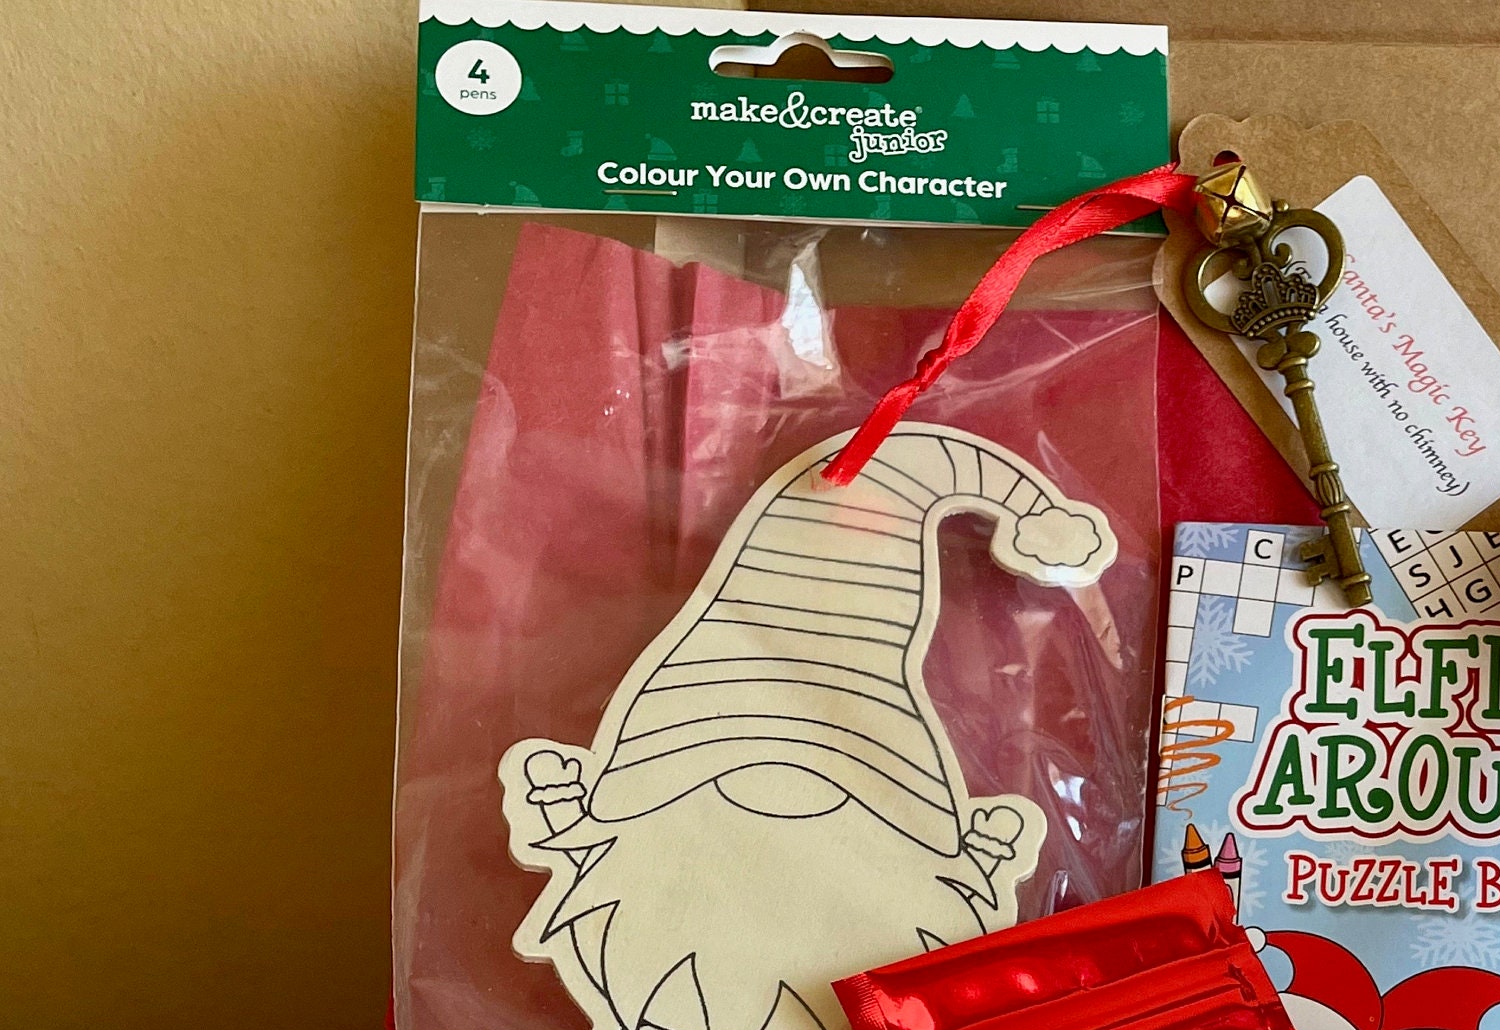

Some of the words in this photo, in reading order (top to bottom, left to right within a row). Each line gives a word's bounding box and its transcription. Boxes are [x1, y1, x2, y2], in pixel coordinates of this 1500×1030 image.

[468, 59, 490, 84] 4
[460, 89, 497, 100] pens
[850, 127, 948, 162] junior
[597, 162, 698, 187] Colour
[706, 166, 776, 189] Your
[784, 168, 850, 192] Own
[858, 171, 1007, 199] Character
[1325, 314, 1364, 361] house
[1361, 362, 1398, 400] with
[1388, 400, 1408, 421] no
[1405, 423, 1471, 497] chimney)
[1392, 334, 1450, 405] Magic
[1446, 406, 1487, 457] Key
[1253, 539, 1273, 559] C
[1387, 529, 1412, 553] E
[1449, 545, 1463, 568] J
[1176, 565, 1194, 585] P
[1408, 563, 1431, 588] S
[1465, 578, 1493, 603] G
[1287, 854, 1458, 909] PUZZLE
